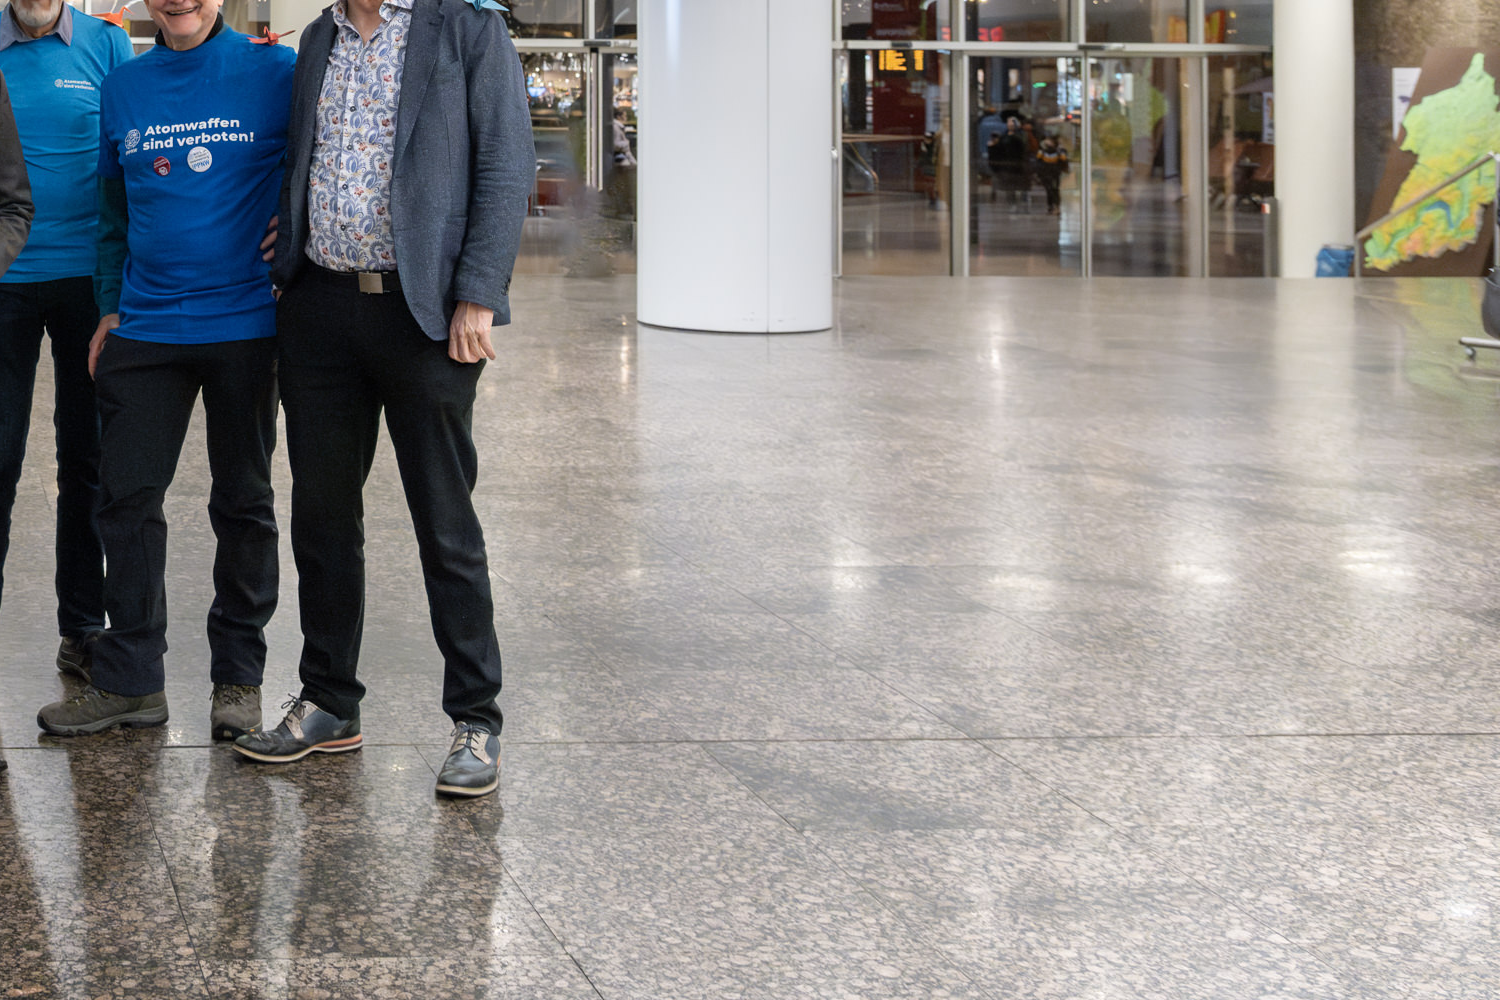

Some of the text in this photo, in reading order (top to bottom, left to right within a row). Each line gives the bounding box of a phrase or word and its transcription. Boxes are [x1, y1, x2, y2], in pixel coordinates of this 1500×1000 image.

[144, 117, 240, 137] Atomwaffen
[142, 131, 255, 151] sind verboten!
